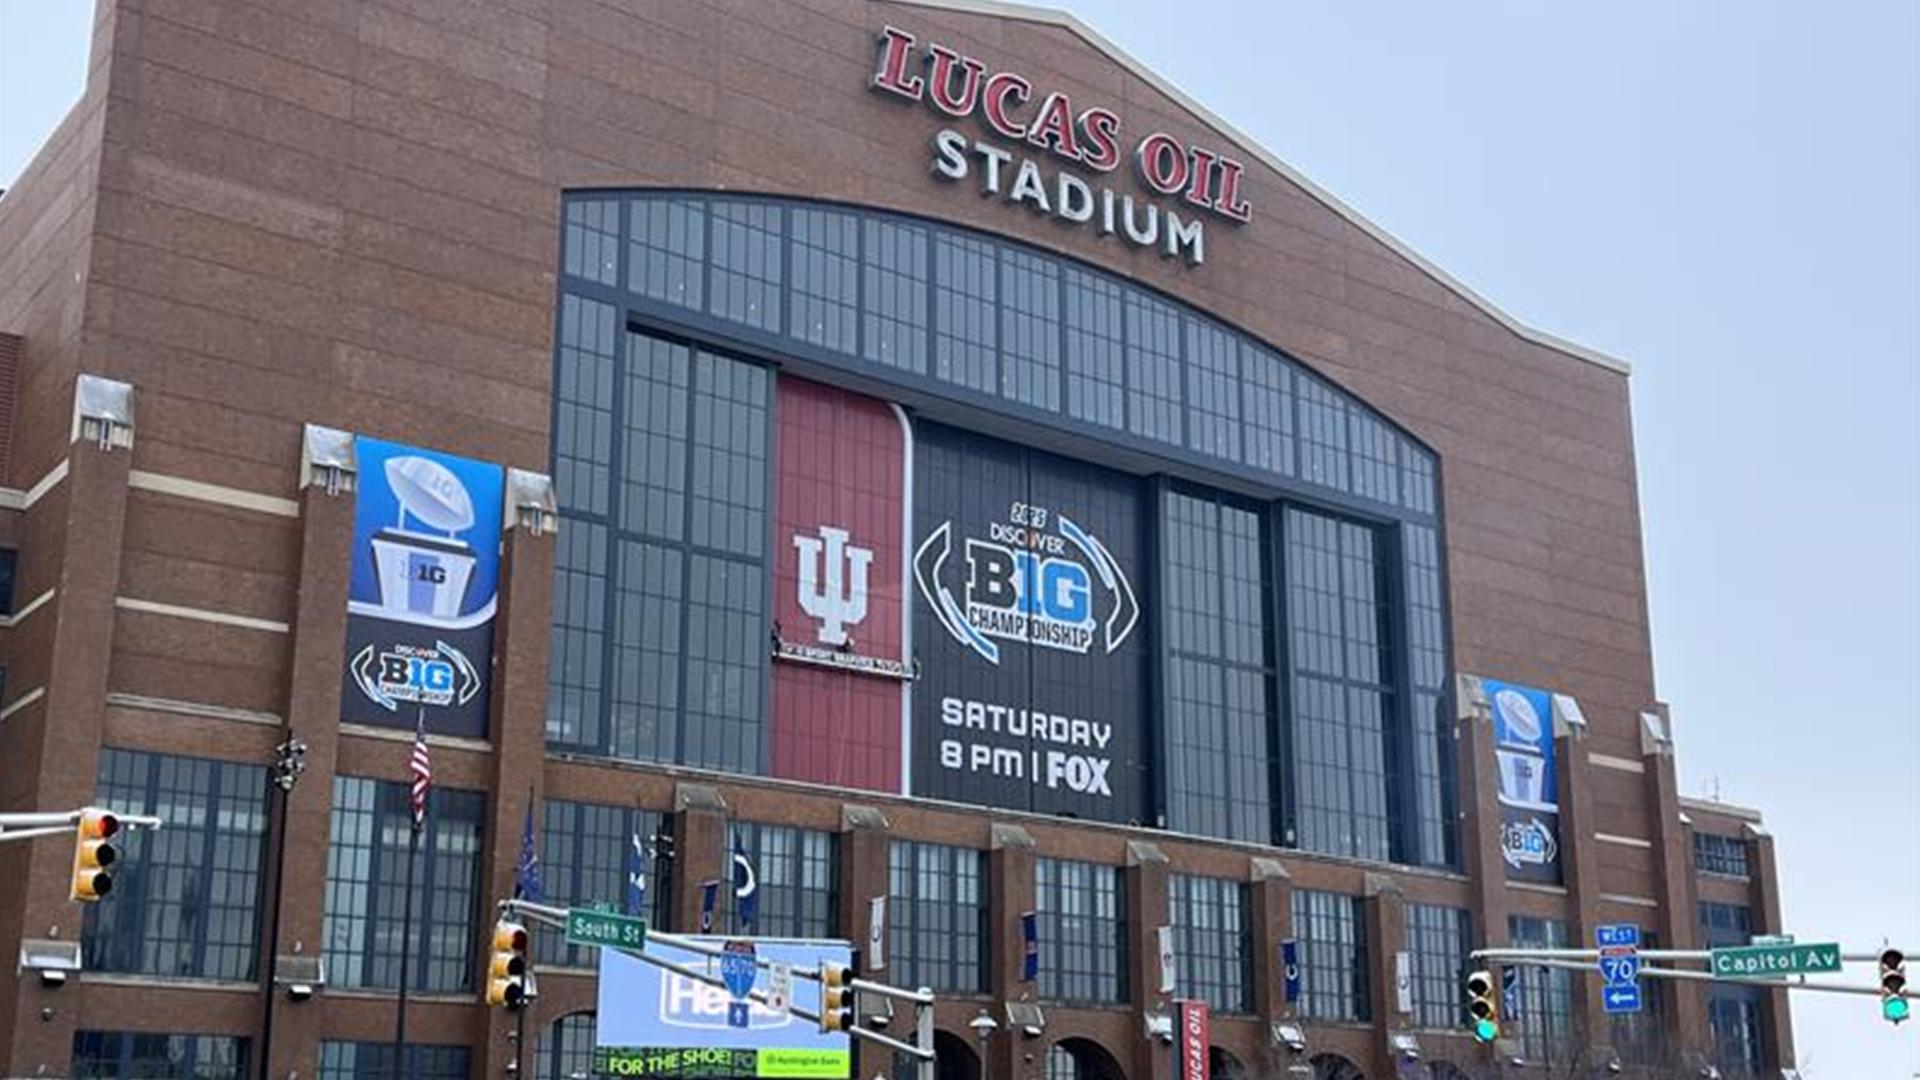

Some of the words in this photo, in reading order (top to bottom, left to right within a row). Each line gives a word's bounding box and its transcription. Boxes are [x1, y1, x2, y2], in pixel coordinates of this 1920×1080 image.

[875, 25, 1120, 172] LUCAS
[1139, 132, 1250, 223] OIL
[935, 129, 1205, 264] STADIUM
[968, 605, 1091, 650] CHAMPIONSHIP
[941, 697, 1112, 750] SATURDAY
[941, 741, 962, 768] 8
[971, 745, 1023, 778] PM
[1047, 750, 1112, 797] FOX
[574, 917, 619, 939] South
[624, 925, 640, 943] St
[1606, 959, 1632, 981] 70
[1717, 951, 1797, 973] Capitol
[1806, 950, 1835, 967] Av
[608, 1056, 644, 1075] FOR
[647, 1052, 680, 1073] THE
